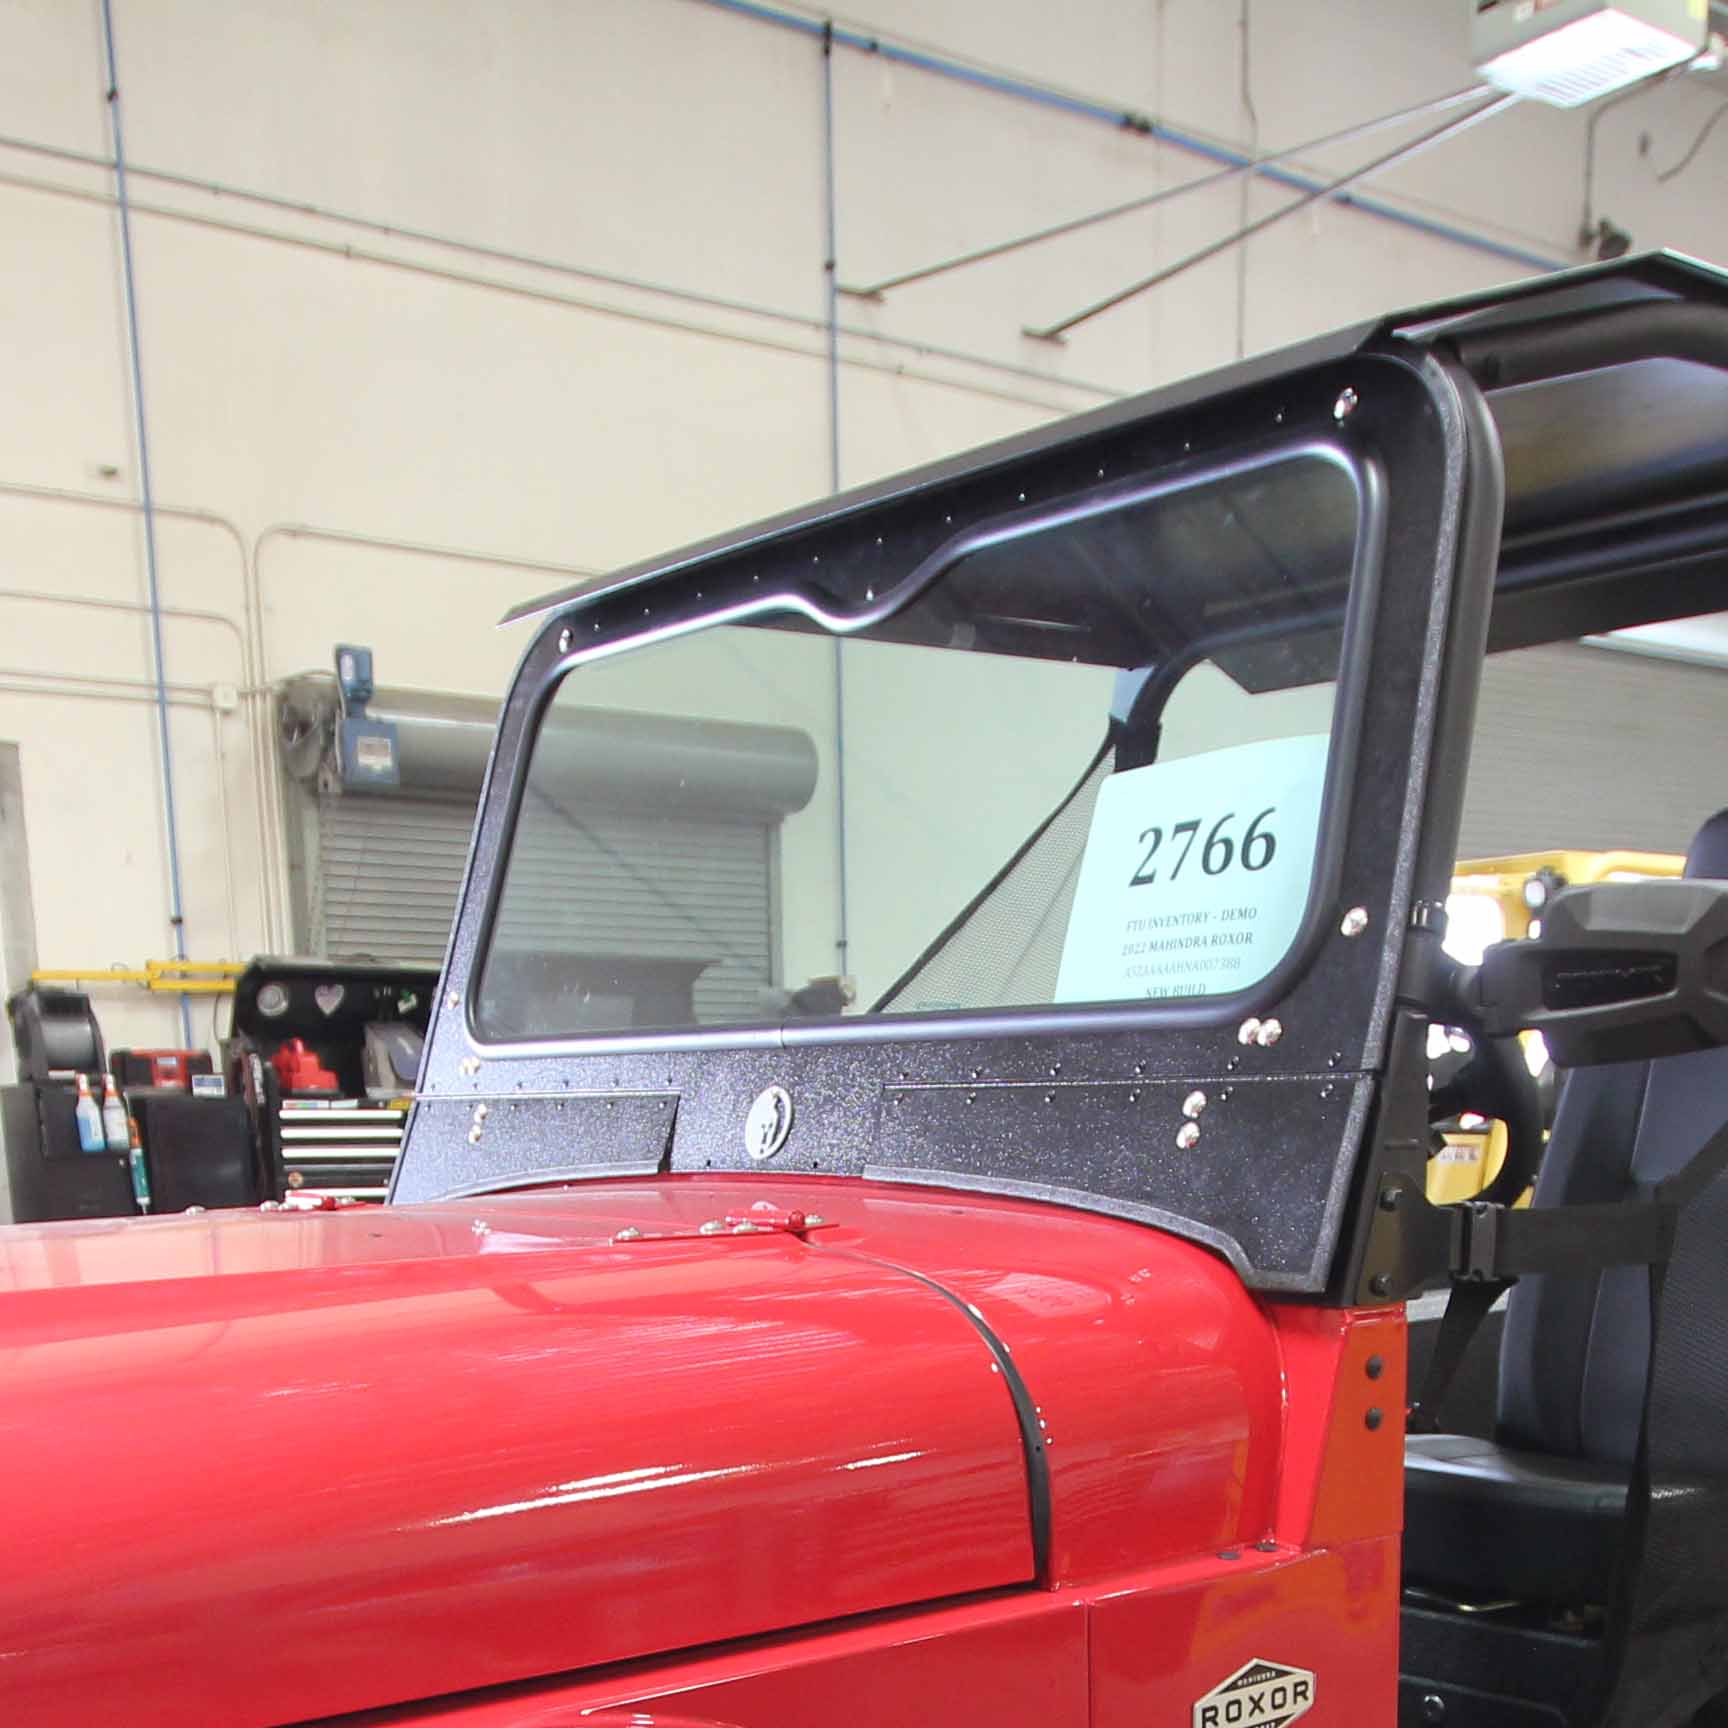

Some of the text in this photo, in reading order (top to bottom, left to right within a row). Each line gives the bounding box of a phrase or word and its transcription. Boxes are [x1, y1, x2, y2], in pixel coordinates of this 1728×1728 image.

[1128, 806, 1277, 888] 2766
[1149, 911, 1210, 929] INVENTORY
[1221, 906, 1257, 922] DEMO
[1148, 935, 1208, 952] MAHINDRA
[1210, 931, 1253, 946] ROXOR
